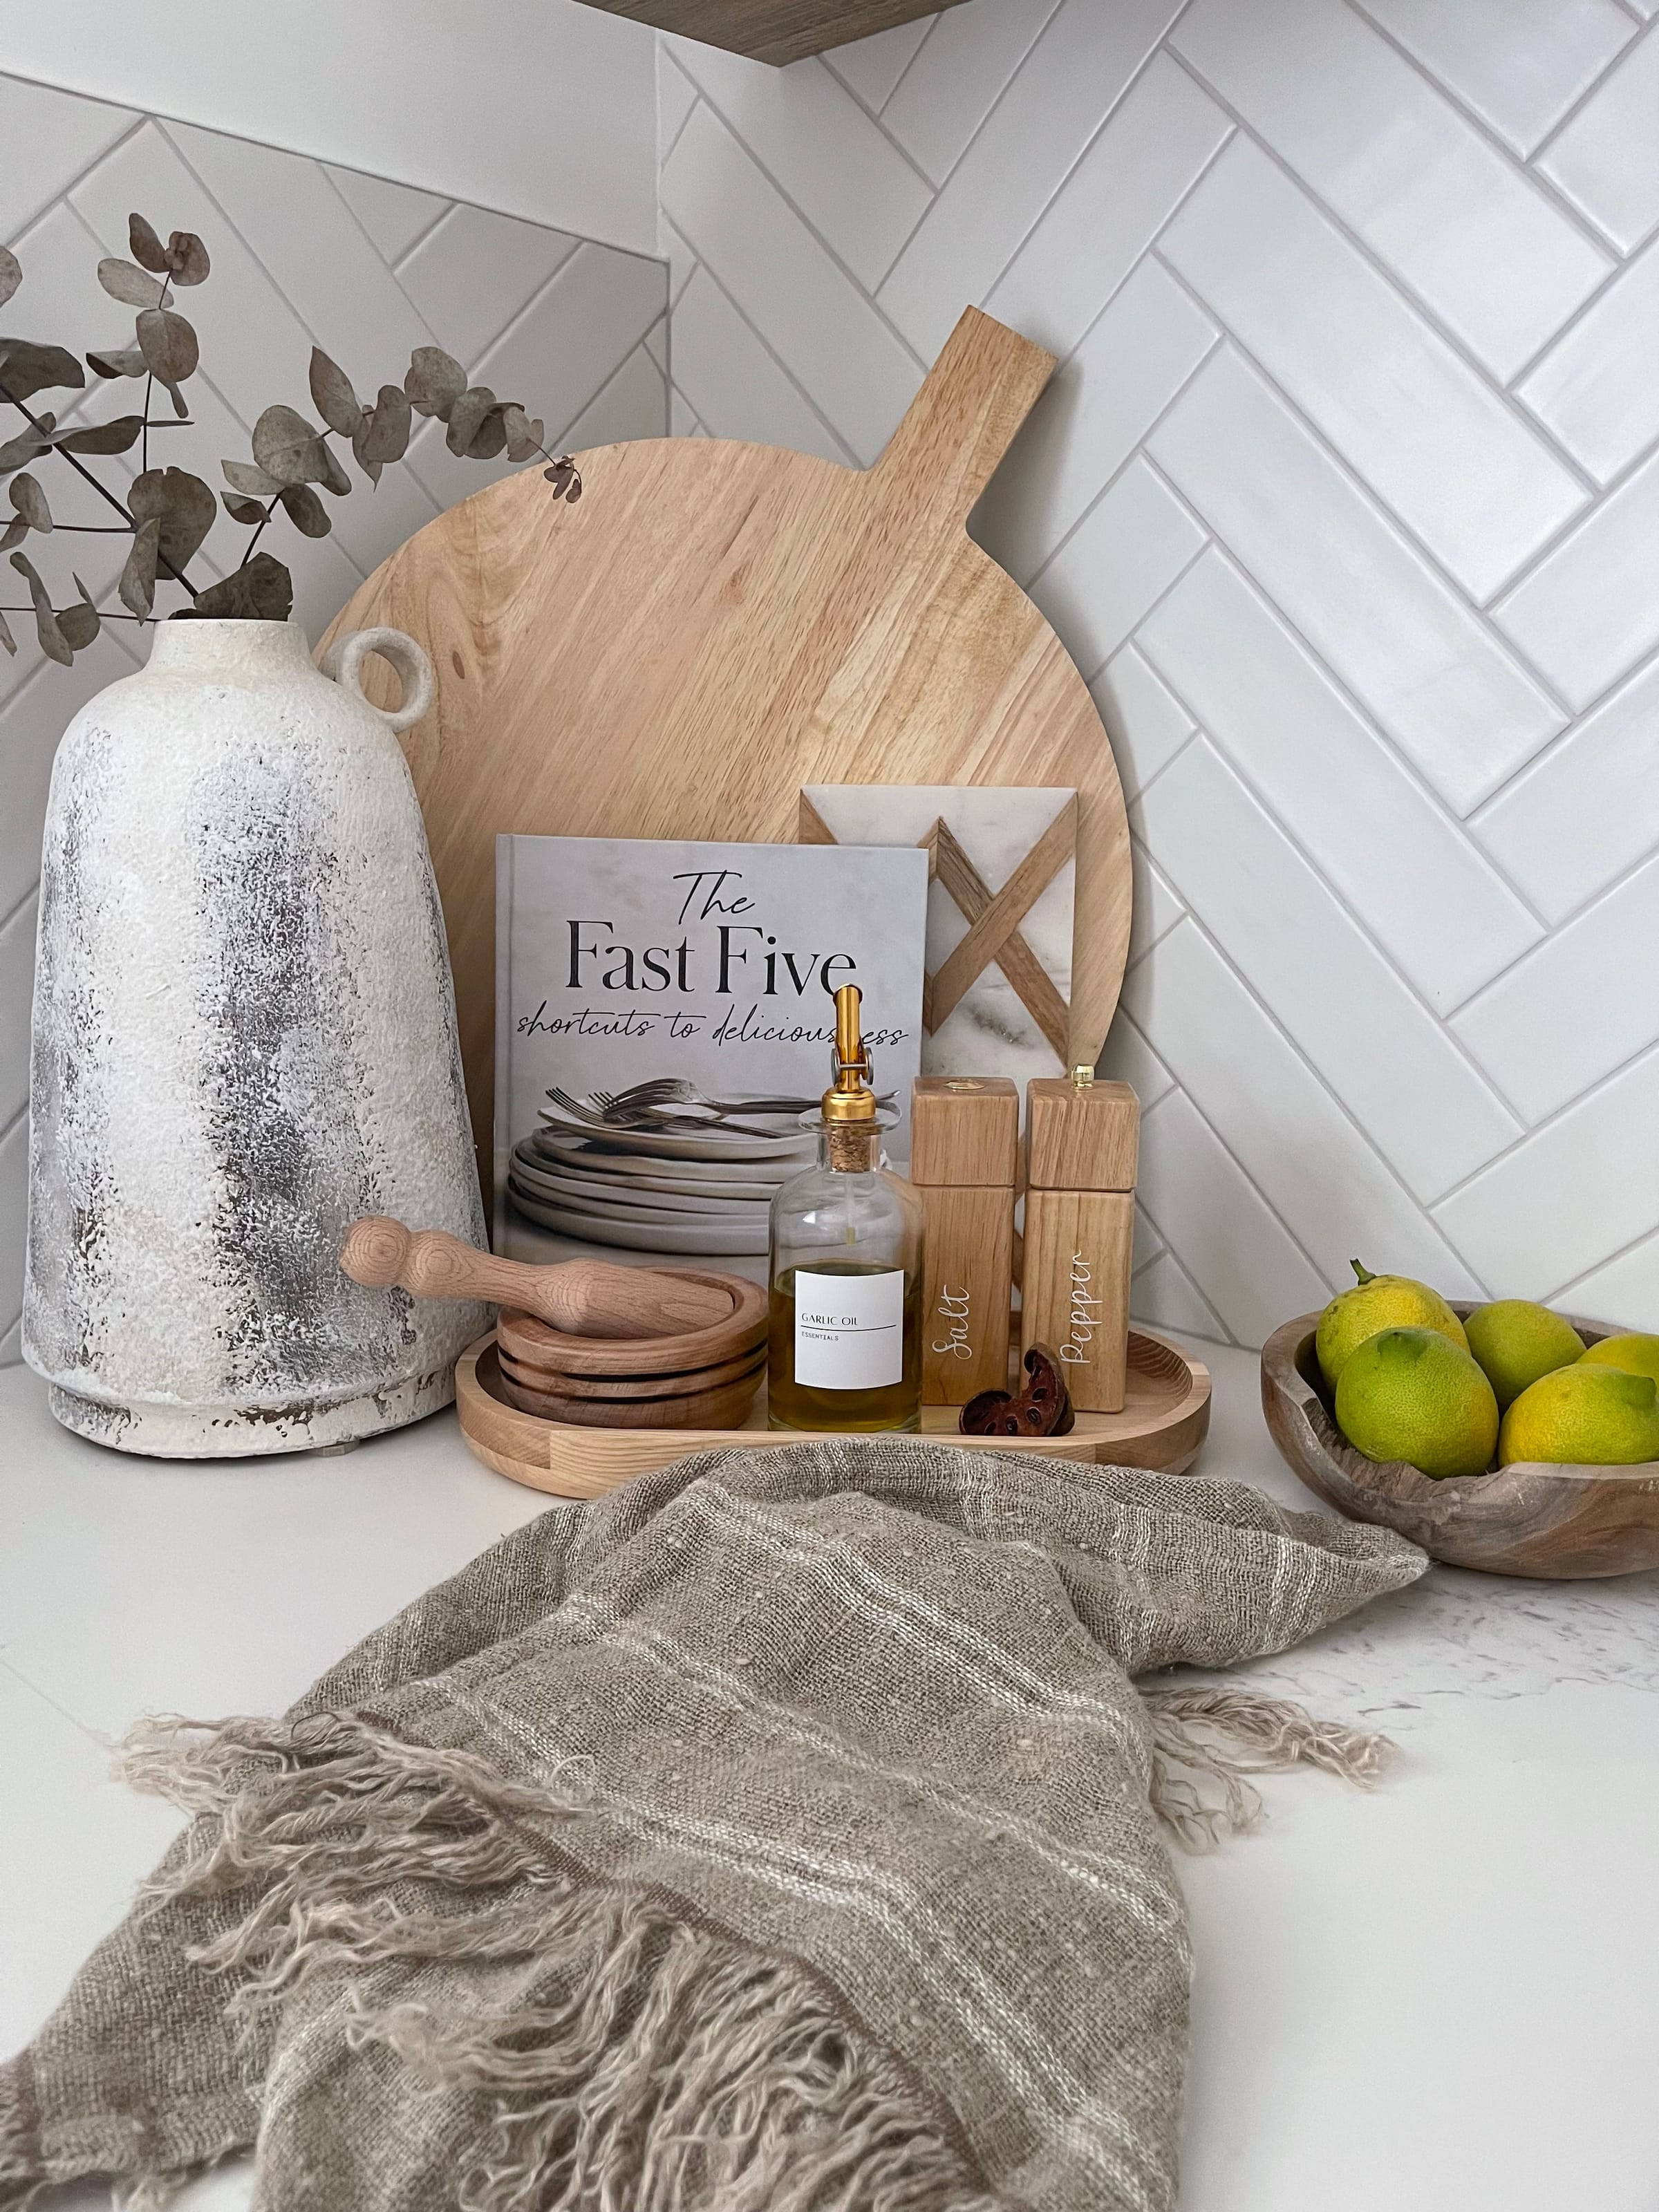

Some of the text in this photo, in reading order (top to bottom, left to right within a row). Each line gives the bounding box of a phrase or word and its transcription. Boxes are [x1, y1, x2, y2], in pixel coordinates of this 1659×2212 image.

[673, 870, 756, 925] The
[565, 919, 857, 997] Fast Five
[516, 1000, 909, 1047] shortcuts to deliciousess
[801, 1313, 838, 1325] GARLIC
[801, 1331, 839, 1341] ESSENTIALS
[932, 1284, 973, 1360] Salt
